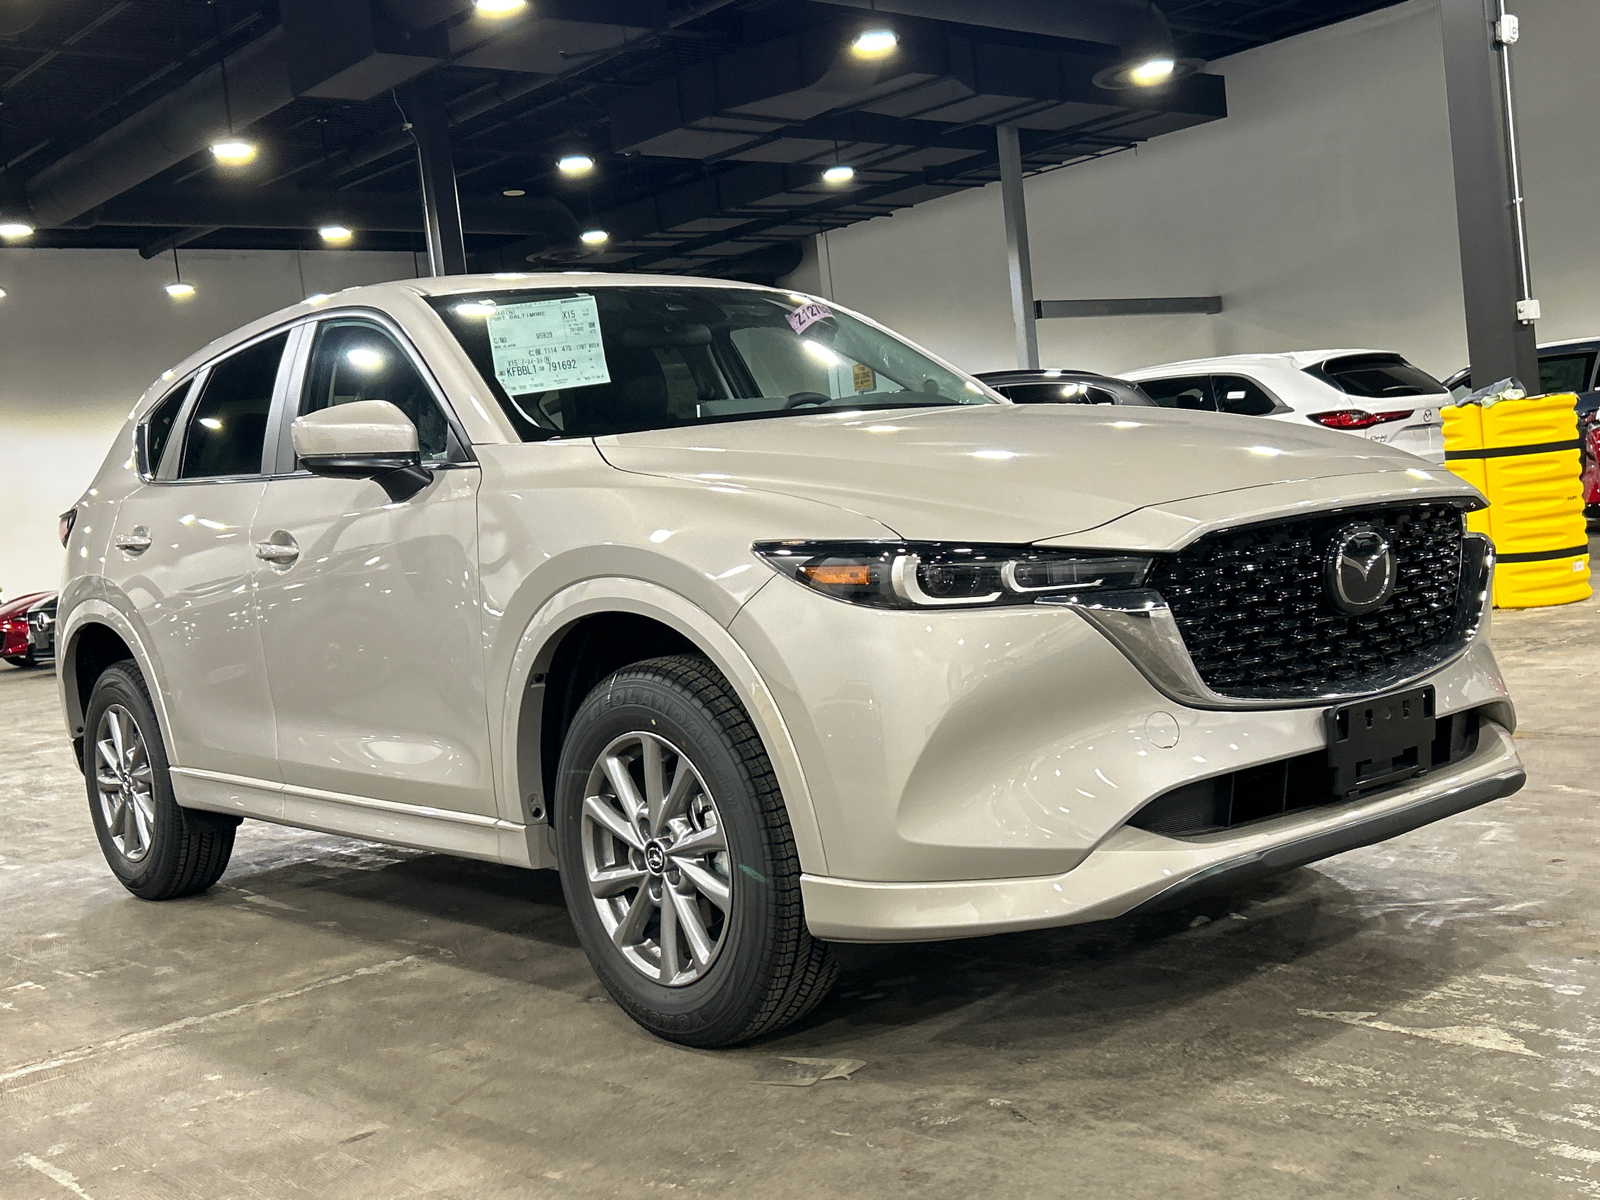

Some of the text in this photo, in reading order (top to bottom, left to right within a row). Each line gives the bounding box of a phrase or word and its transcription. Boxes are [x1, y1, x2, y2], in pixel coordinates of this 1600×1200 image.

[510, 311, 546, 320] BALTIMORE
[562, 310, 576, 320] X15
[548, 359, 577, 372] 791692
[588, 688, 718, 762] GEOLANDAR
